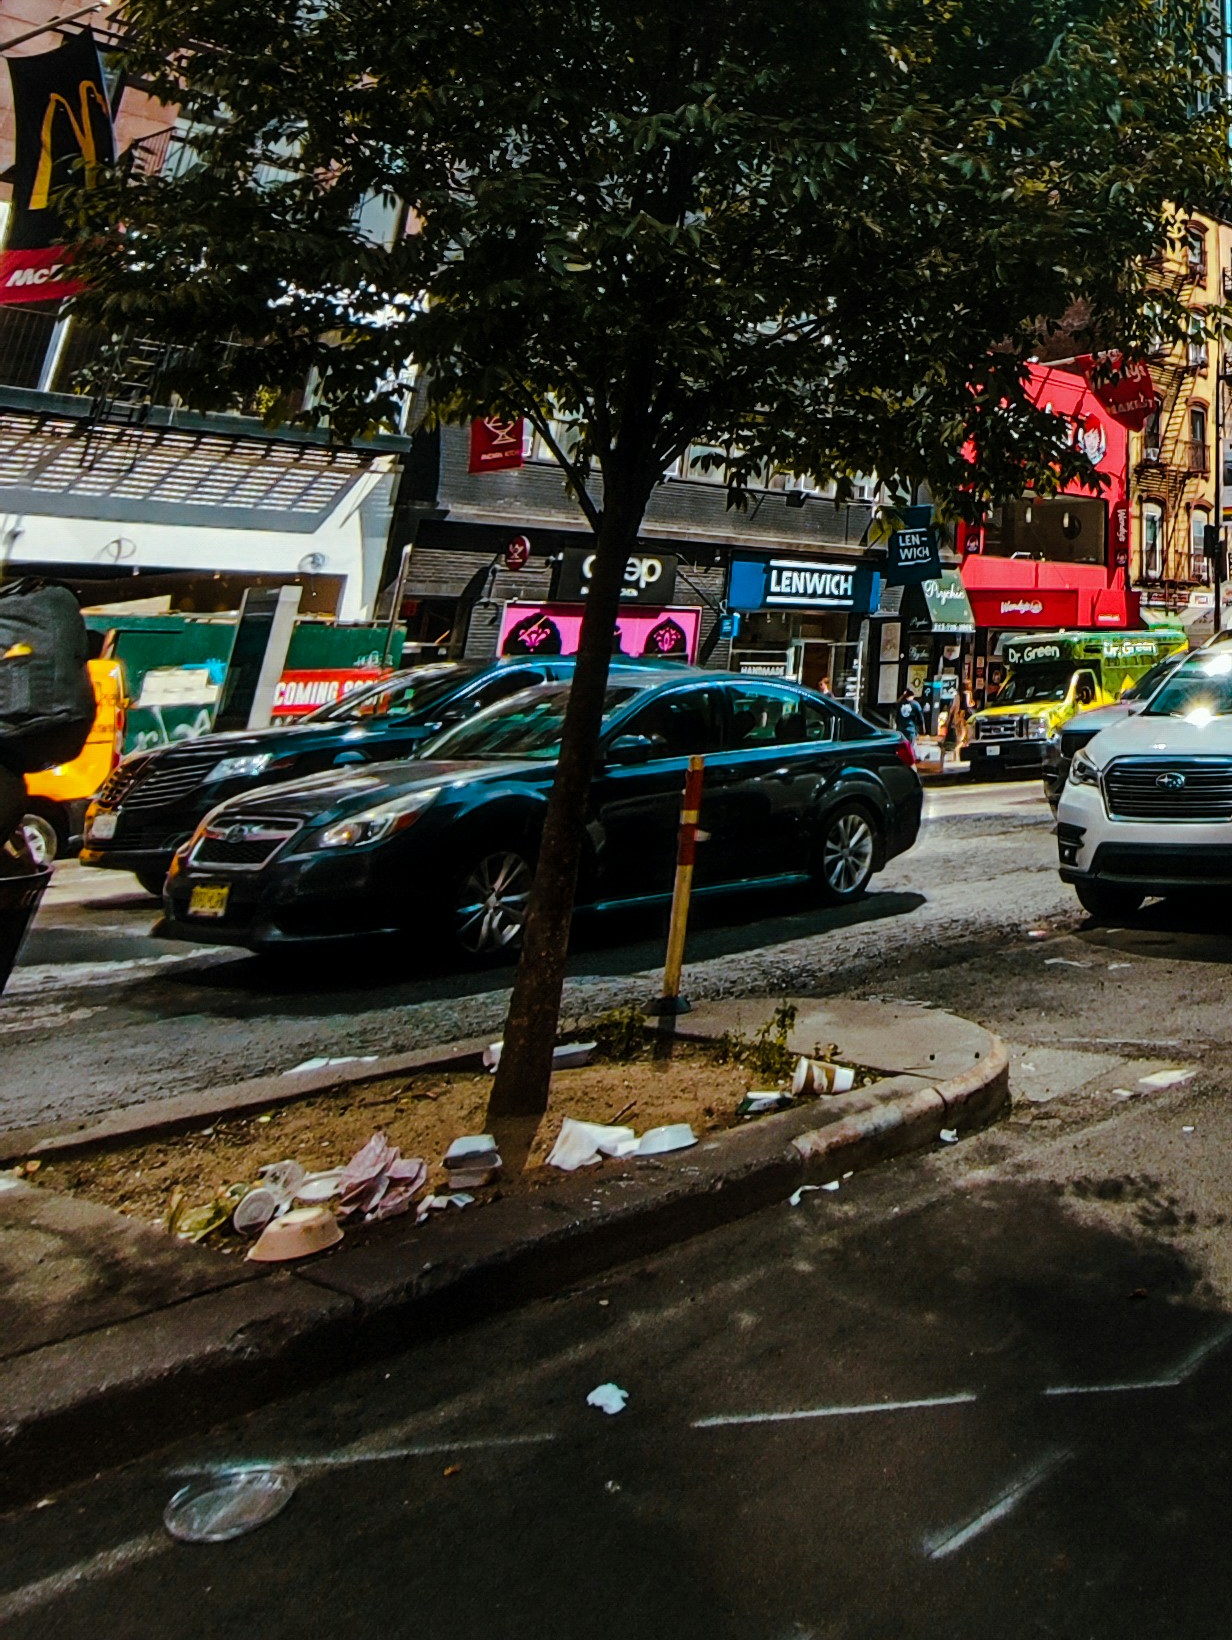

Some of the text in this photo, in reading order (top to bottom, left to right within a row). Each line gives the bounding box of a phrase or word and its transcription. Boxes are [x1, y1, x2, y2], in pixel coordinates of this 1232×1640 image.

[898, 533, 928, 547] LEN-
[899, 546, 930, 560] WICH
[770, 569, 853, 596] LENWICH
[1008, 645, 1060, 664] Dr. Green
[272, 681, 341, 706] COMING
